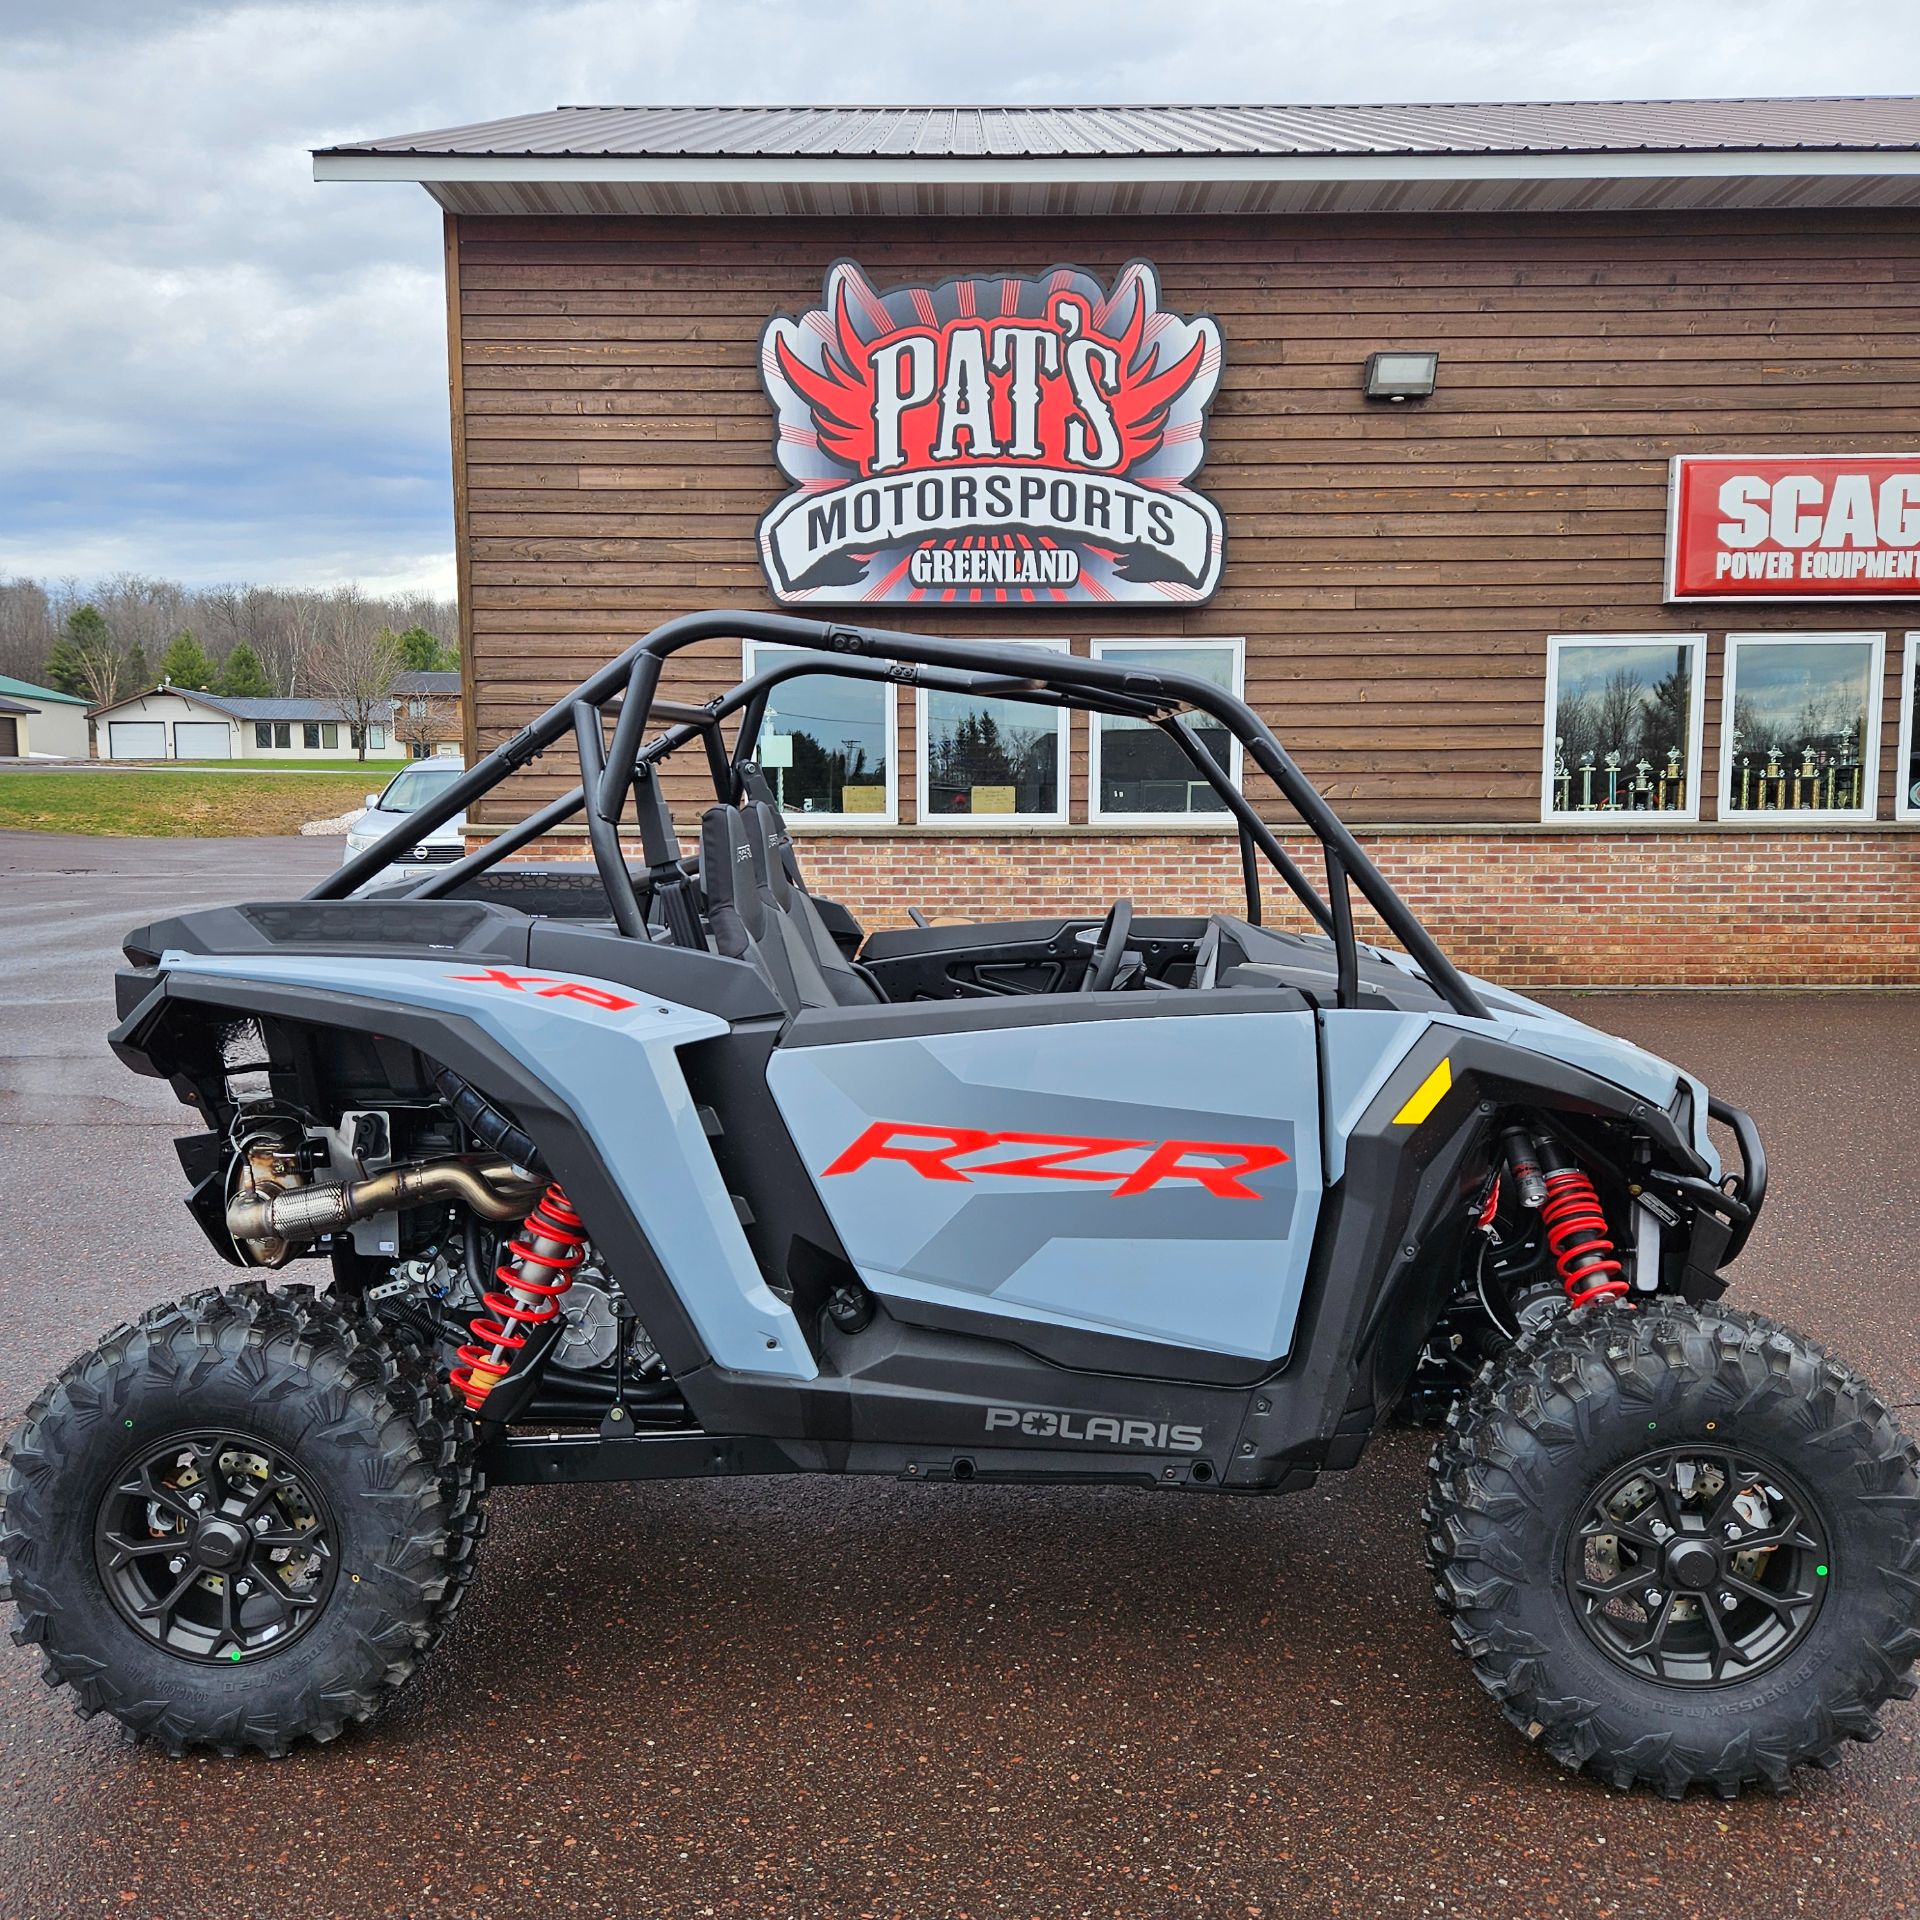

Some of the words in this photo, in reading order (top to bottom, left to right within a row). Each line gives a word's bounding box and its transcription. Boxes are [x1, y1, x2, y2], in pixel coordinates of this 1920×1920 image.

[870, 302, 1121, 471] PAT'S
[807, 476, 1176, 552] MOTORSPORTS
[1717, 474, 1920, 548] SCAG
[911, 548, 1080, 584] GREENLAND
[1715, 551, 1795, 580] POWER
[820, 1121, 1291, 1200] RZR
[984, 1407, 1203, 1452] POLARIS
